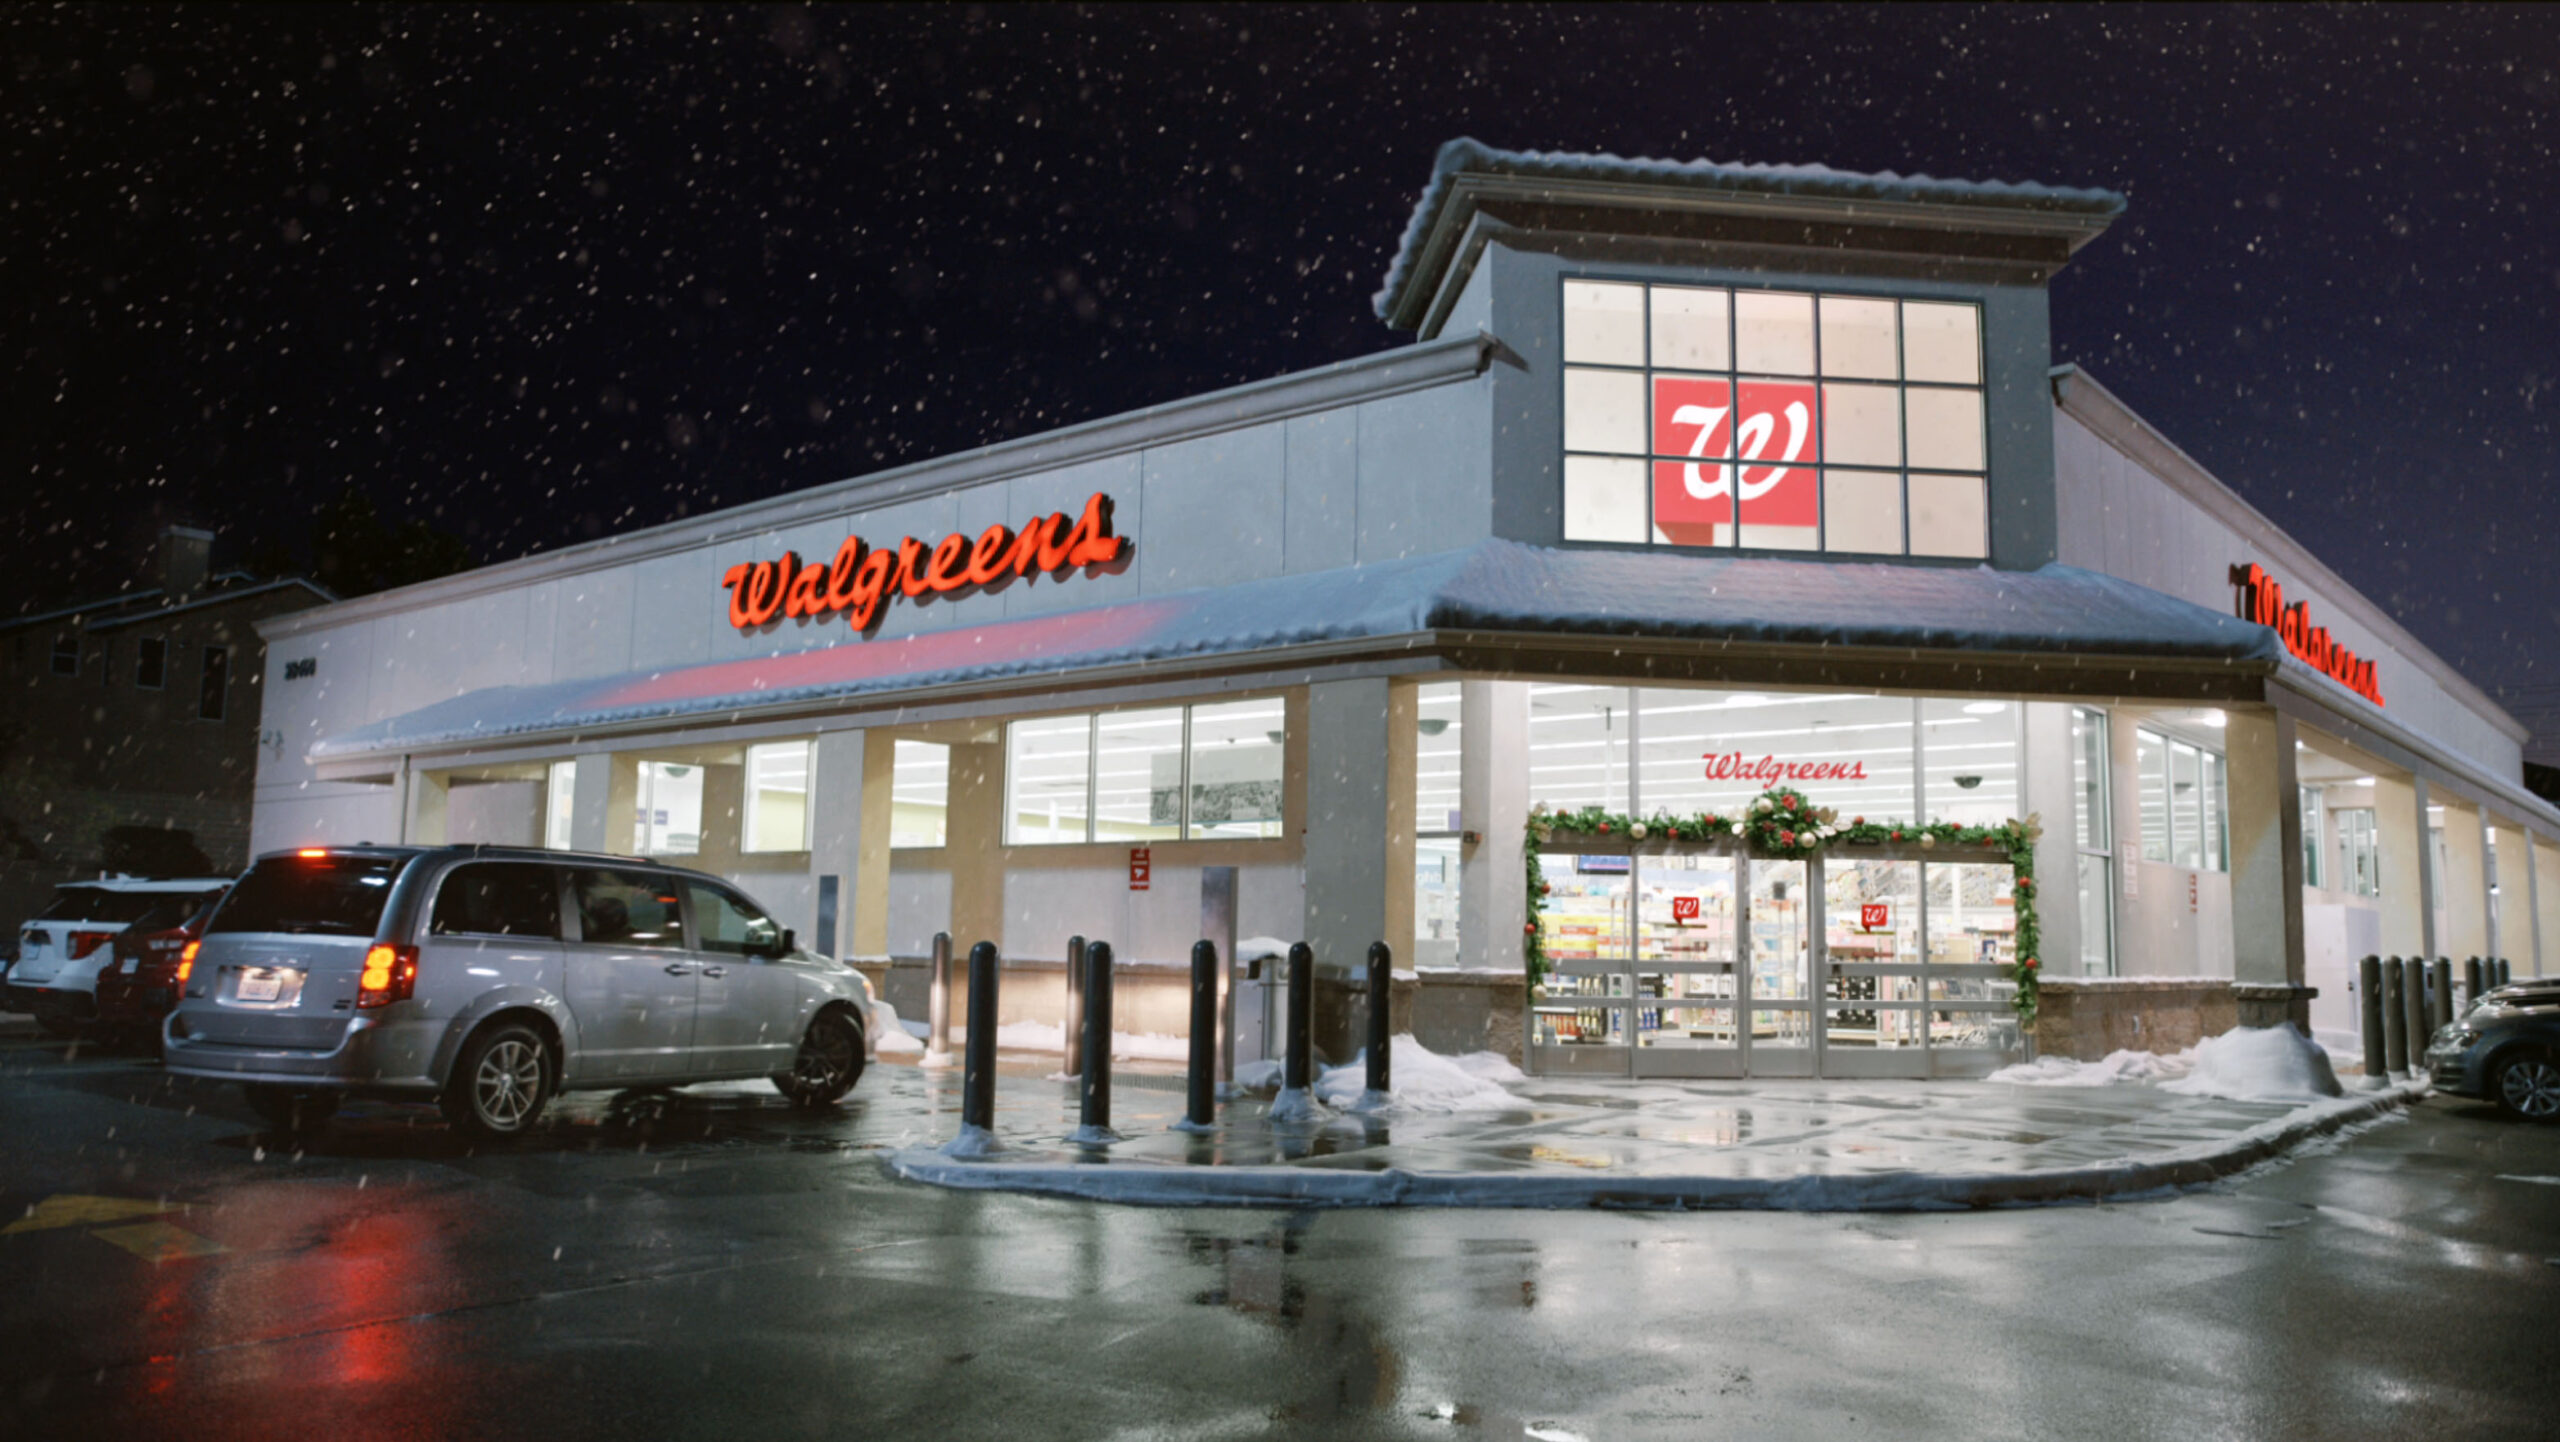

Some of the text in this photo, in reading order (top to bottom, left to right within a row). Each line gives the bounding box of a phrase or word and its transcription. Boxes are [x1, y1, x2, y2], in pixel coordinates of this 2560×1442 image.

[1671, 400, 1809, 501] W
[721, 491, 1122, 632] Walgreens
[1702, 751, 1869, 789] Walgreens
[1675, 899, 1697, 915] W
[1864, 906, 1886, 923] W
